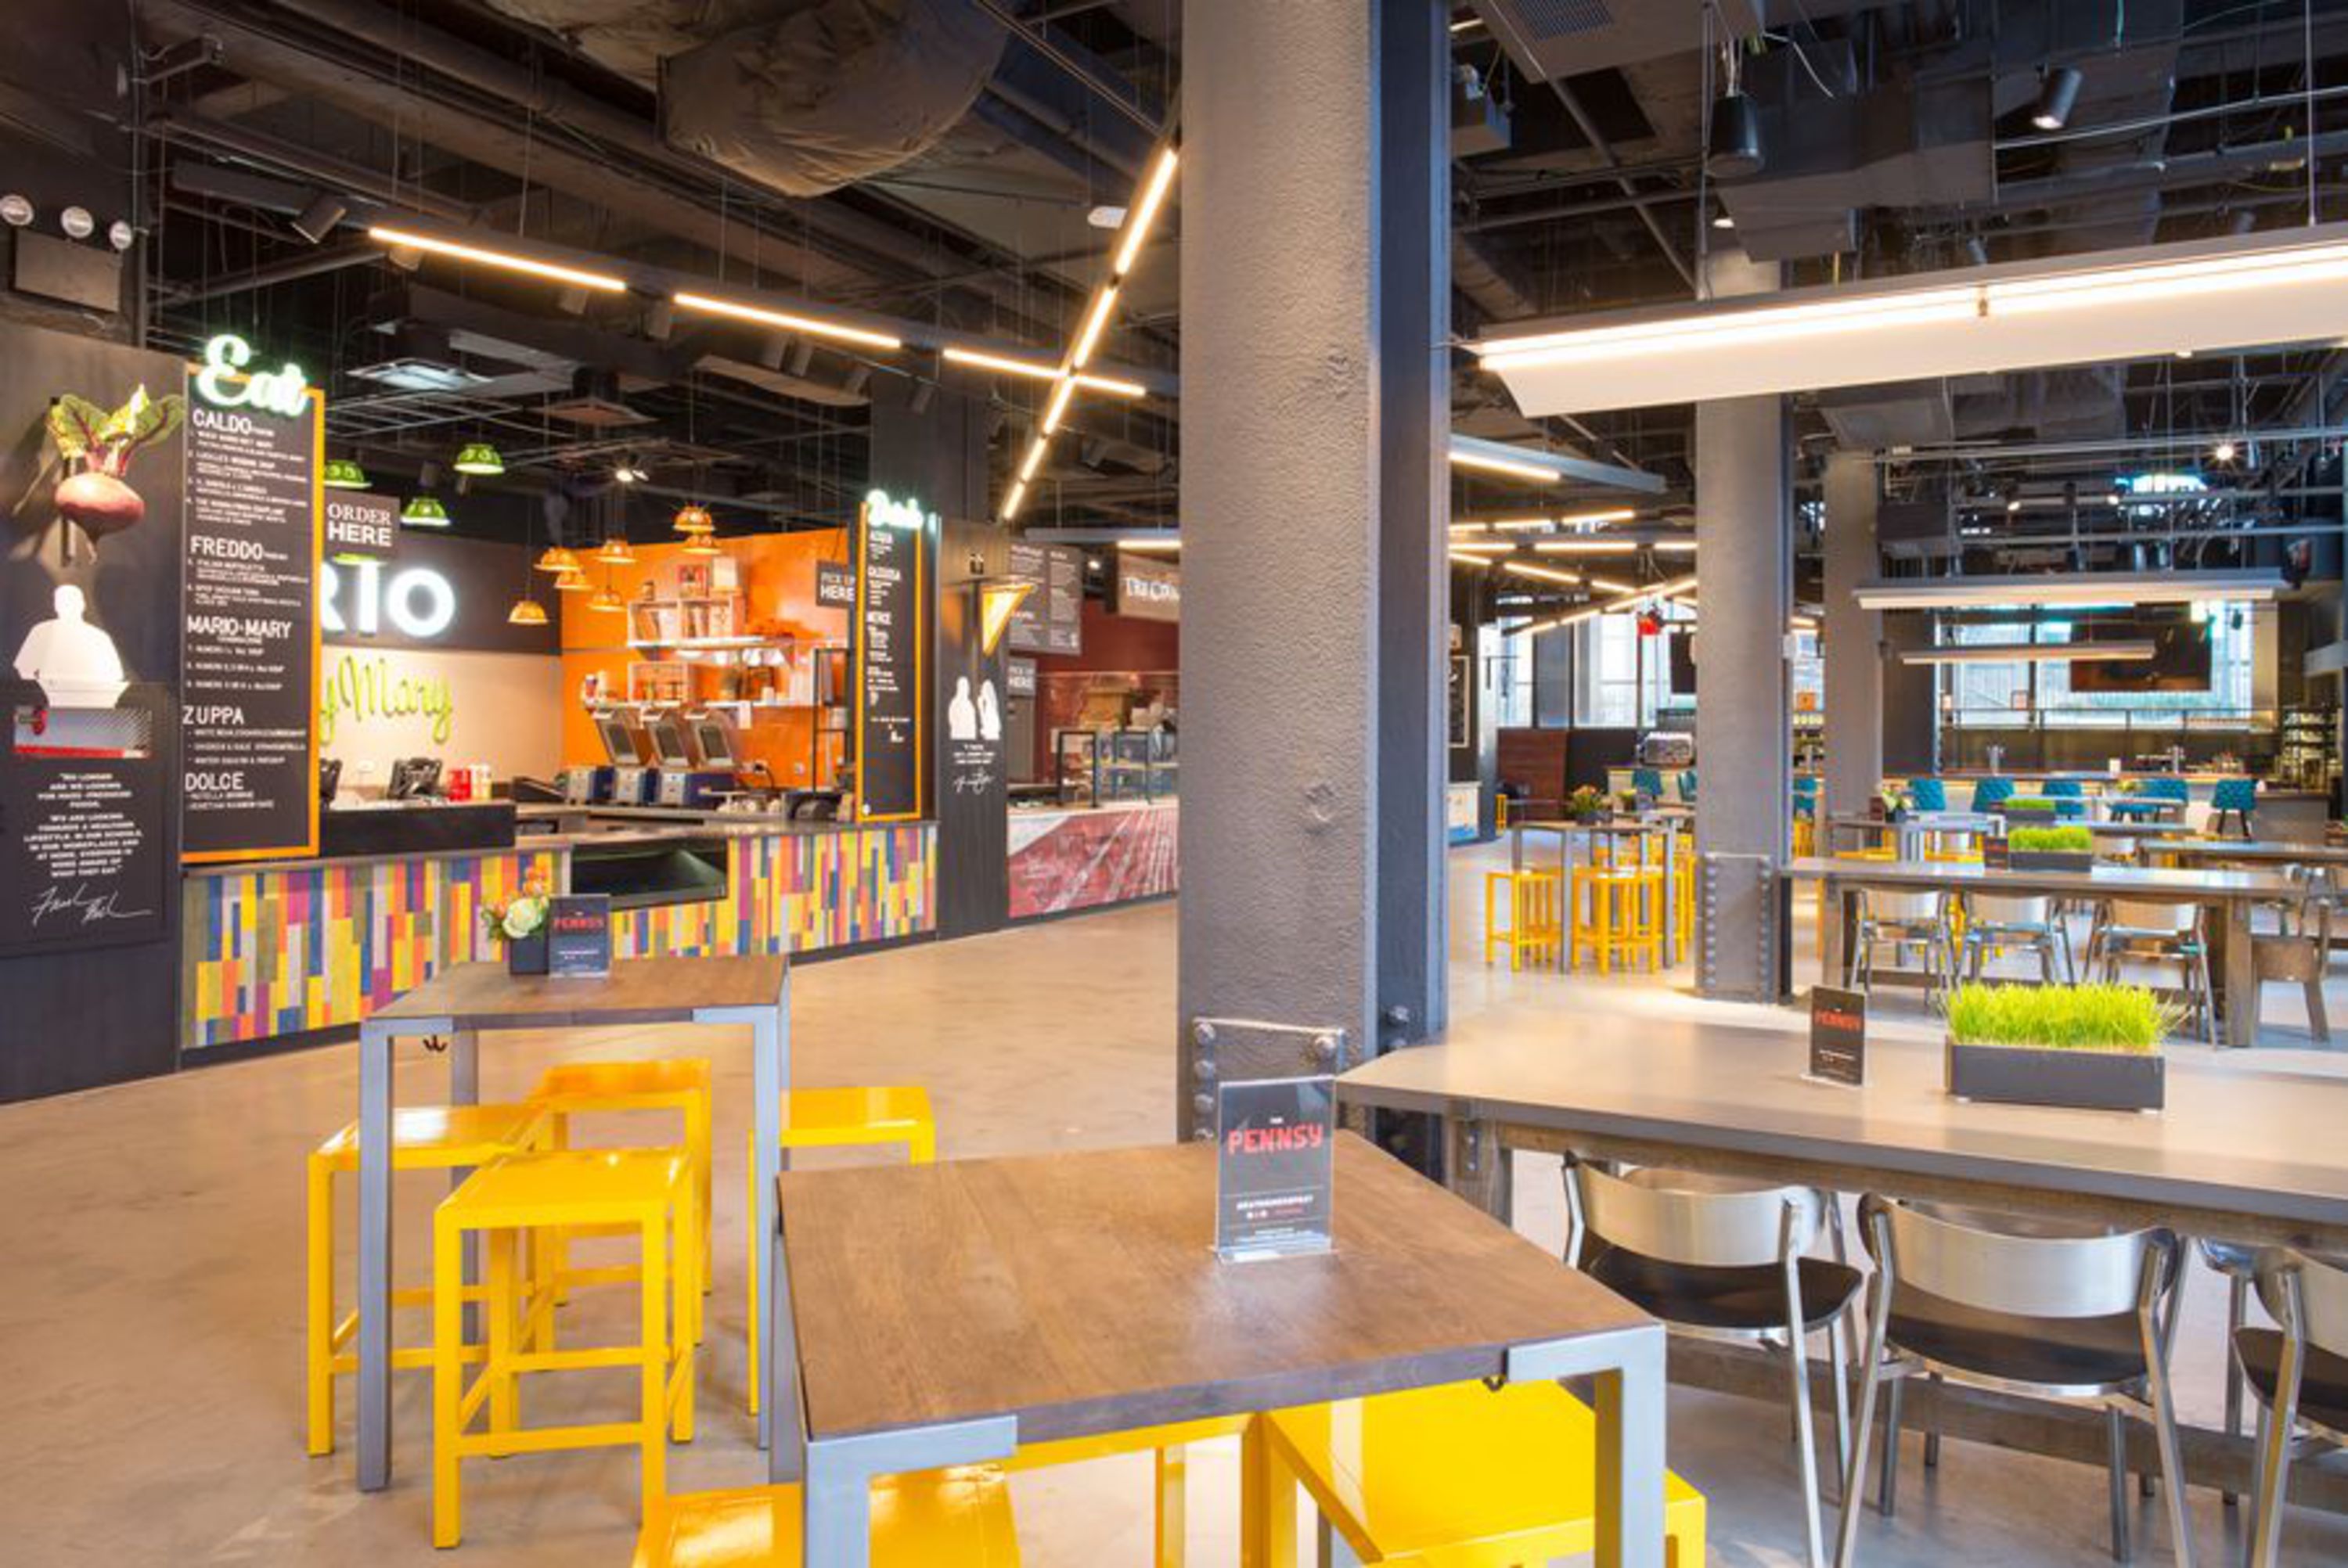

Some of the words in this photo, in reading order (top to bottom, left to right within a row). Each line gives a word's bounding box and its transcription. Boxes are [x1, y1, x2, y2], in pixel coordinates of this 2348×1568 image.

[197, 333, 308, 417] Eat
[193, 408, 253, 436] CALDO
[327, 502, 392, 526] ORDER
[328, 521, 392, 547] HERE
[190, 534, 264, 562] FREDDO
[820, 584, 855, 602] HERE
[339, 655, 452, 745] Mary
[182, 705, 245, 725] ZUPPA
[185, 771, 244, 791] DOLCE
[1227, 1122, 1323, 1156] PENNSY
